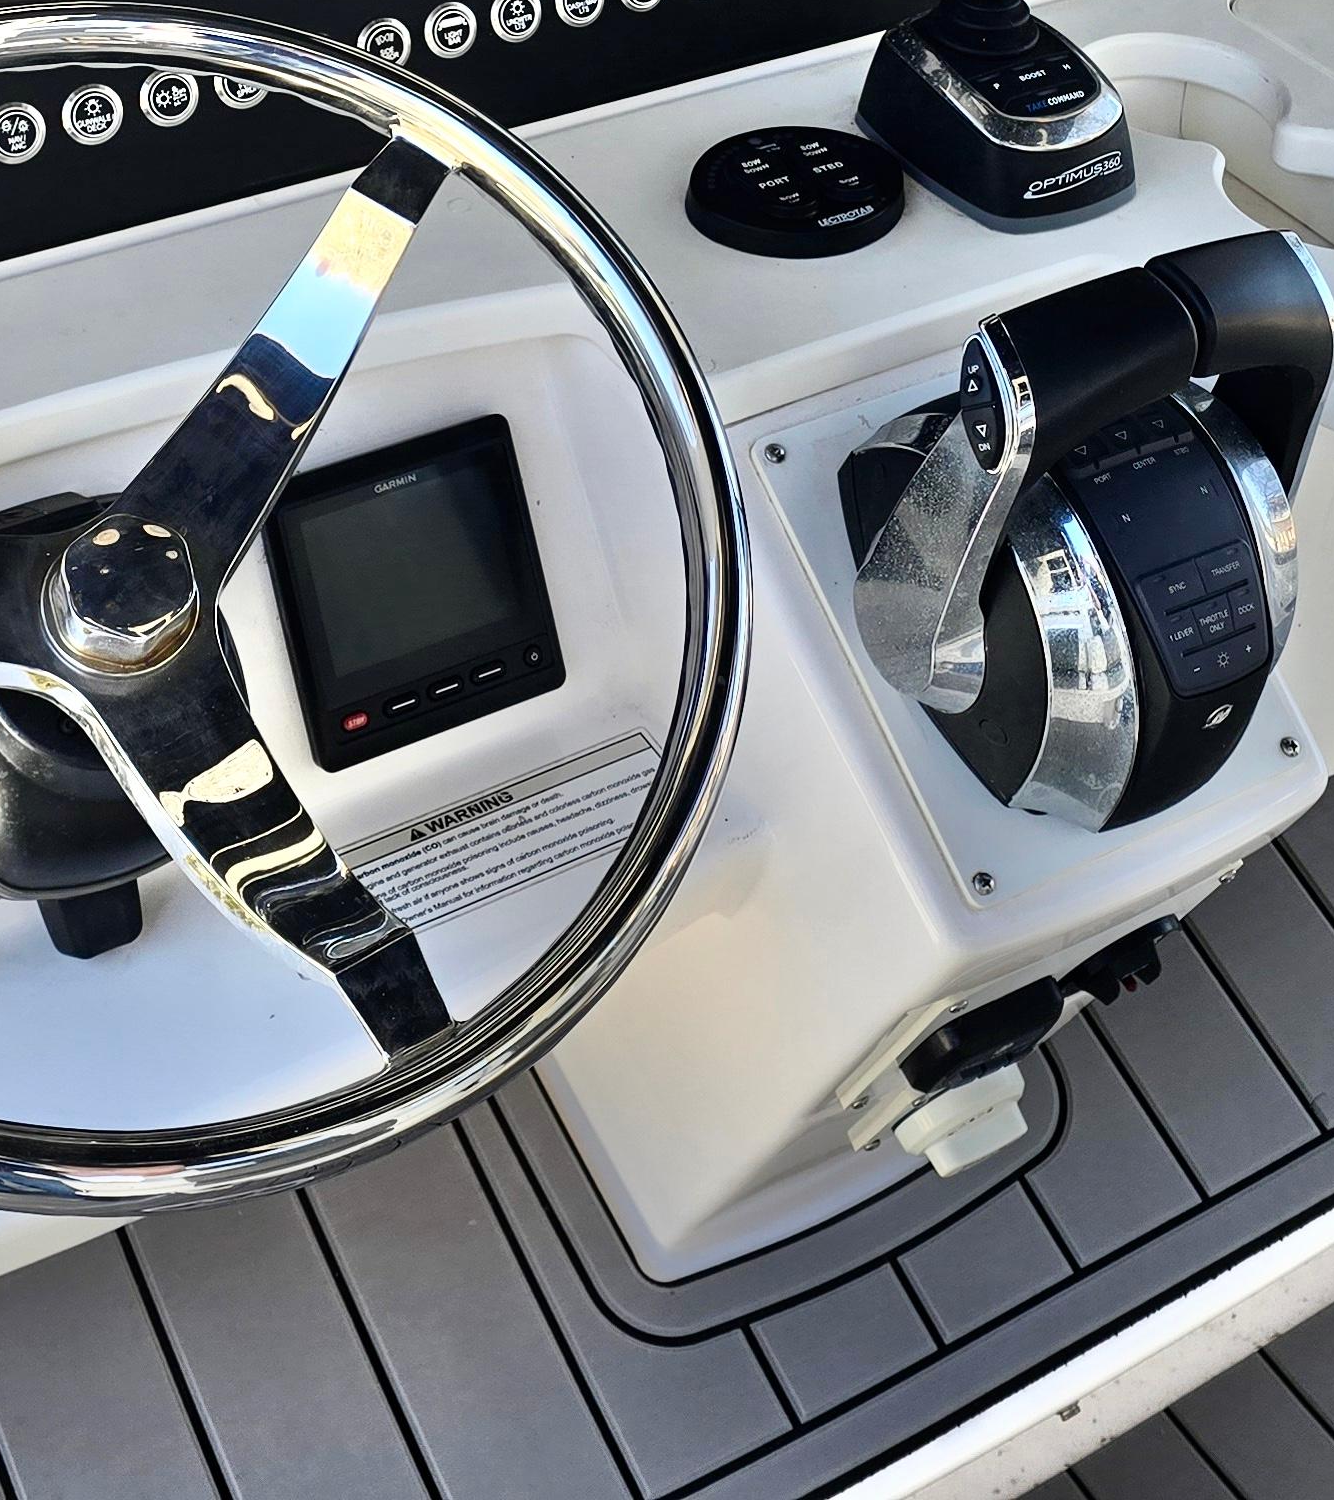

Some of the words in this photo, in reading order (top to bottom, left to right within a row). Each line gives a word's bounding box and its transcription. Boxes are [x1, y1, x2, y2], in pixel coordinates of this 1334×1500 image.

[1019, 69, 1047, 82] BOOST
[1026, 100, 1048, 113] TAKE
[1047, 90, 1085, 106] COMMAND
[813, 161, 844, 174] STBD
[758, 176, 790, 190] PORT
[967, 364, 979, 374] UP
[978, 442, 991, 452] DN
[1094, 472, 1112, 485] PORT
[1132, 456, 1157, 470] CENTER
[373, 473, 418, 494] GARMIN
[1199, 485, 1209, 495] N
[1121, 513, 1131, 523] N
[1168, 581, 1187, 594] SYNC
[1211, 560, 1241, 576] TRANSFER
[1199, 609, 1229, 626] THROTTLE
[1238, 603, 1255, 615] DOCK
[1174, 626, 1194, 641] LEVER
[1209, 622, 1225, 633] ONLY
[424, 791, 514, 833] WARNING
[385, 872, 400, 881] and
[402, 857, 438, 875] generator
[439, 844, 468, 859] exhaust
[470, 831, 499, 846] contains
[534, 810, 547, 819] and
[548, 797, 580, 813] colorless
[581, 787, 605, 800] carbon
[607, 772, 640, 789] monoxide
[357, 866, 379, 879] arbon
[381, 849, 421, 869] monoxide
[422, 840, 441, 853] (CO)
[442, 836, 456, 844] can
[458, 826, 479, 838] cause
[480, 817, 500, 829] brain
[500, 804, 530, 821] damage
[388, 886, 397, 894] of
[397, 876, 423, 890] carbon
[425, 860, 461, 878] monoxide
[463, 845, 498, 864] poisoning
[499, 833, 525, 847] include
[431, 883, 459, 898] anyone
[460, 871, 484, 884] shows
[485, 862, 505, 875] signs
[515, 847, 540, 861] carbon
[541, 832, 576, 850] monoxide
[433, 894, 462, 909] Manual
[463, 889, 473, 897] for
[474, 871, 516, 892] information
[517, 856, 552, 874] regarding
[553, 845, 578, 859] carbon
[579, 830, 614, 848] monoxide
